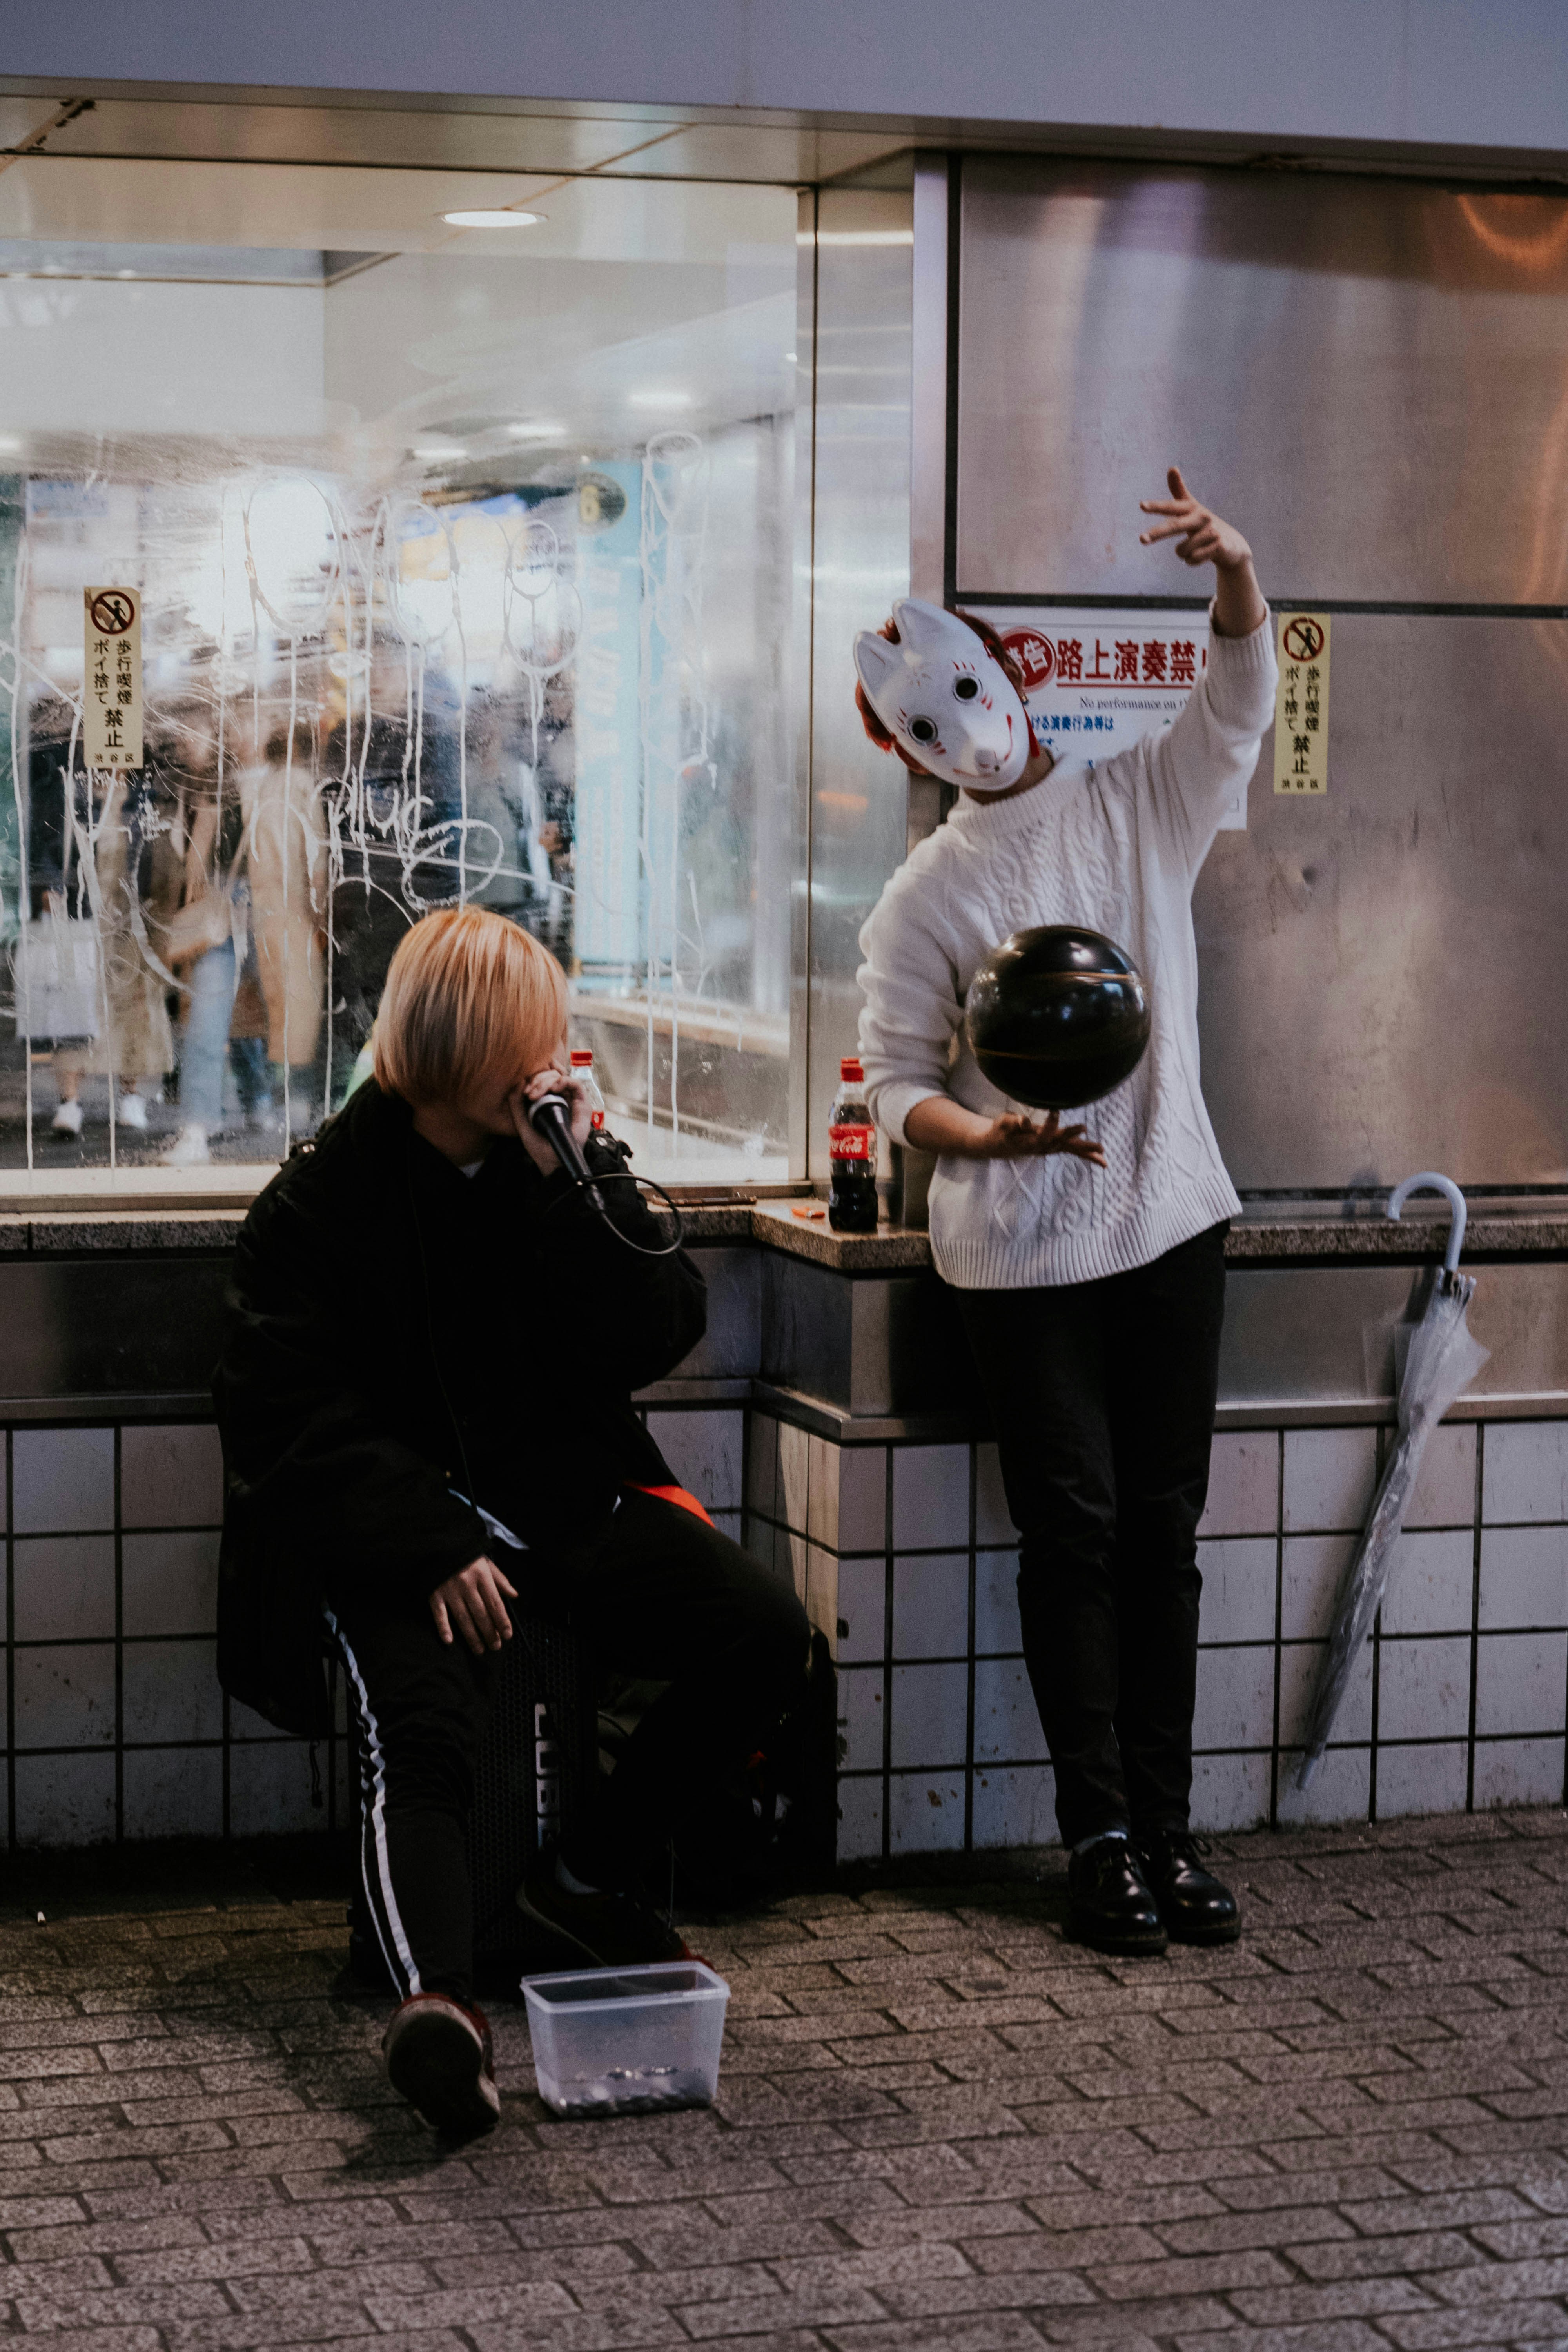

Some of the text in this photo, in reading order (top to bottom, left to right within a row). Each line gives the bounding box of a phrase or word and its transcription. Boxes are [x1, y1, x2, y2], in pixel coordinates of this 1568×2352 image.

[94, 638, 110, 704] ポイ捨て
[116, 639, 132, 706] 歩行喫煙
[1057, 637, 1207, 682] 路上演奏禁
[1080, 696, 1094, 709] No
[1097, 697, 1161, 710] performance
[1163, 700, 1177, 709] on
[1284, 664, 1300, 731] ポイ捨て
[1305, 665, 1320, 732] 歩行喫煙
[104, 708, 124, 747] 禁止
[94, 753, 134, 763] 渋谷区
[1292, 733, 1310, 774] 禁止
